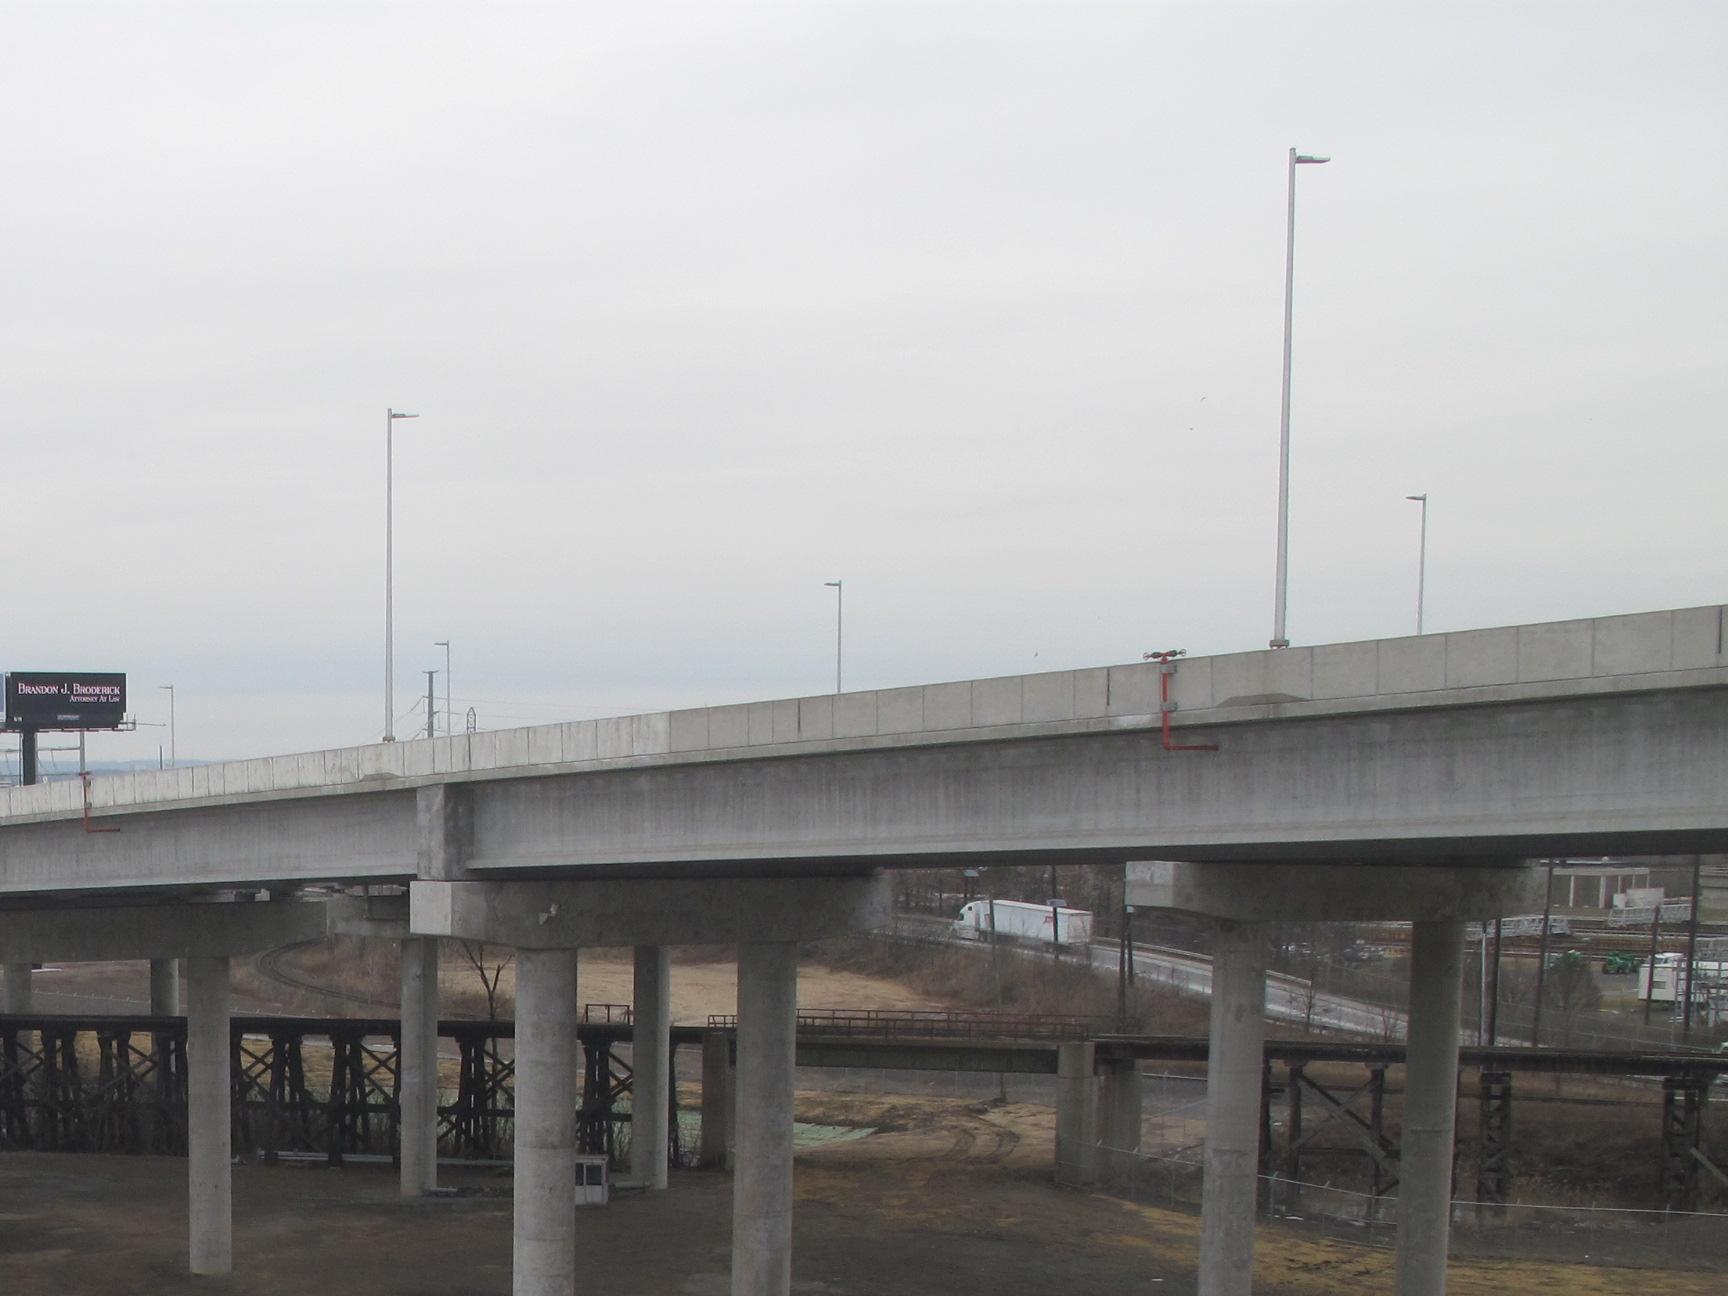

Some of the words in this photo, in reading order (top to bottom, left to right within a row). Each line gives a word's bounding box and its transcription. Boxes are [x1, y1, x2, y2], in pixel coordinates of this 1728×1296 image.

[18, 683, 59, 695] BRANDON
[61, 683, 70, 695] J.
[73, 683, 120, 695] BRODERICK
